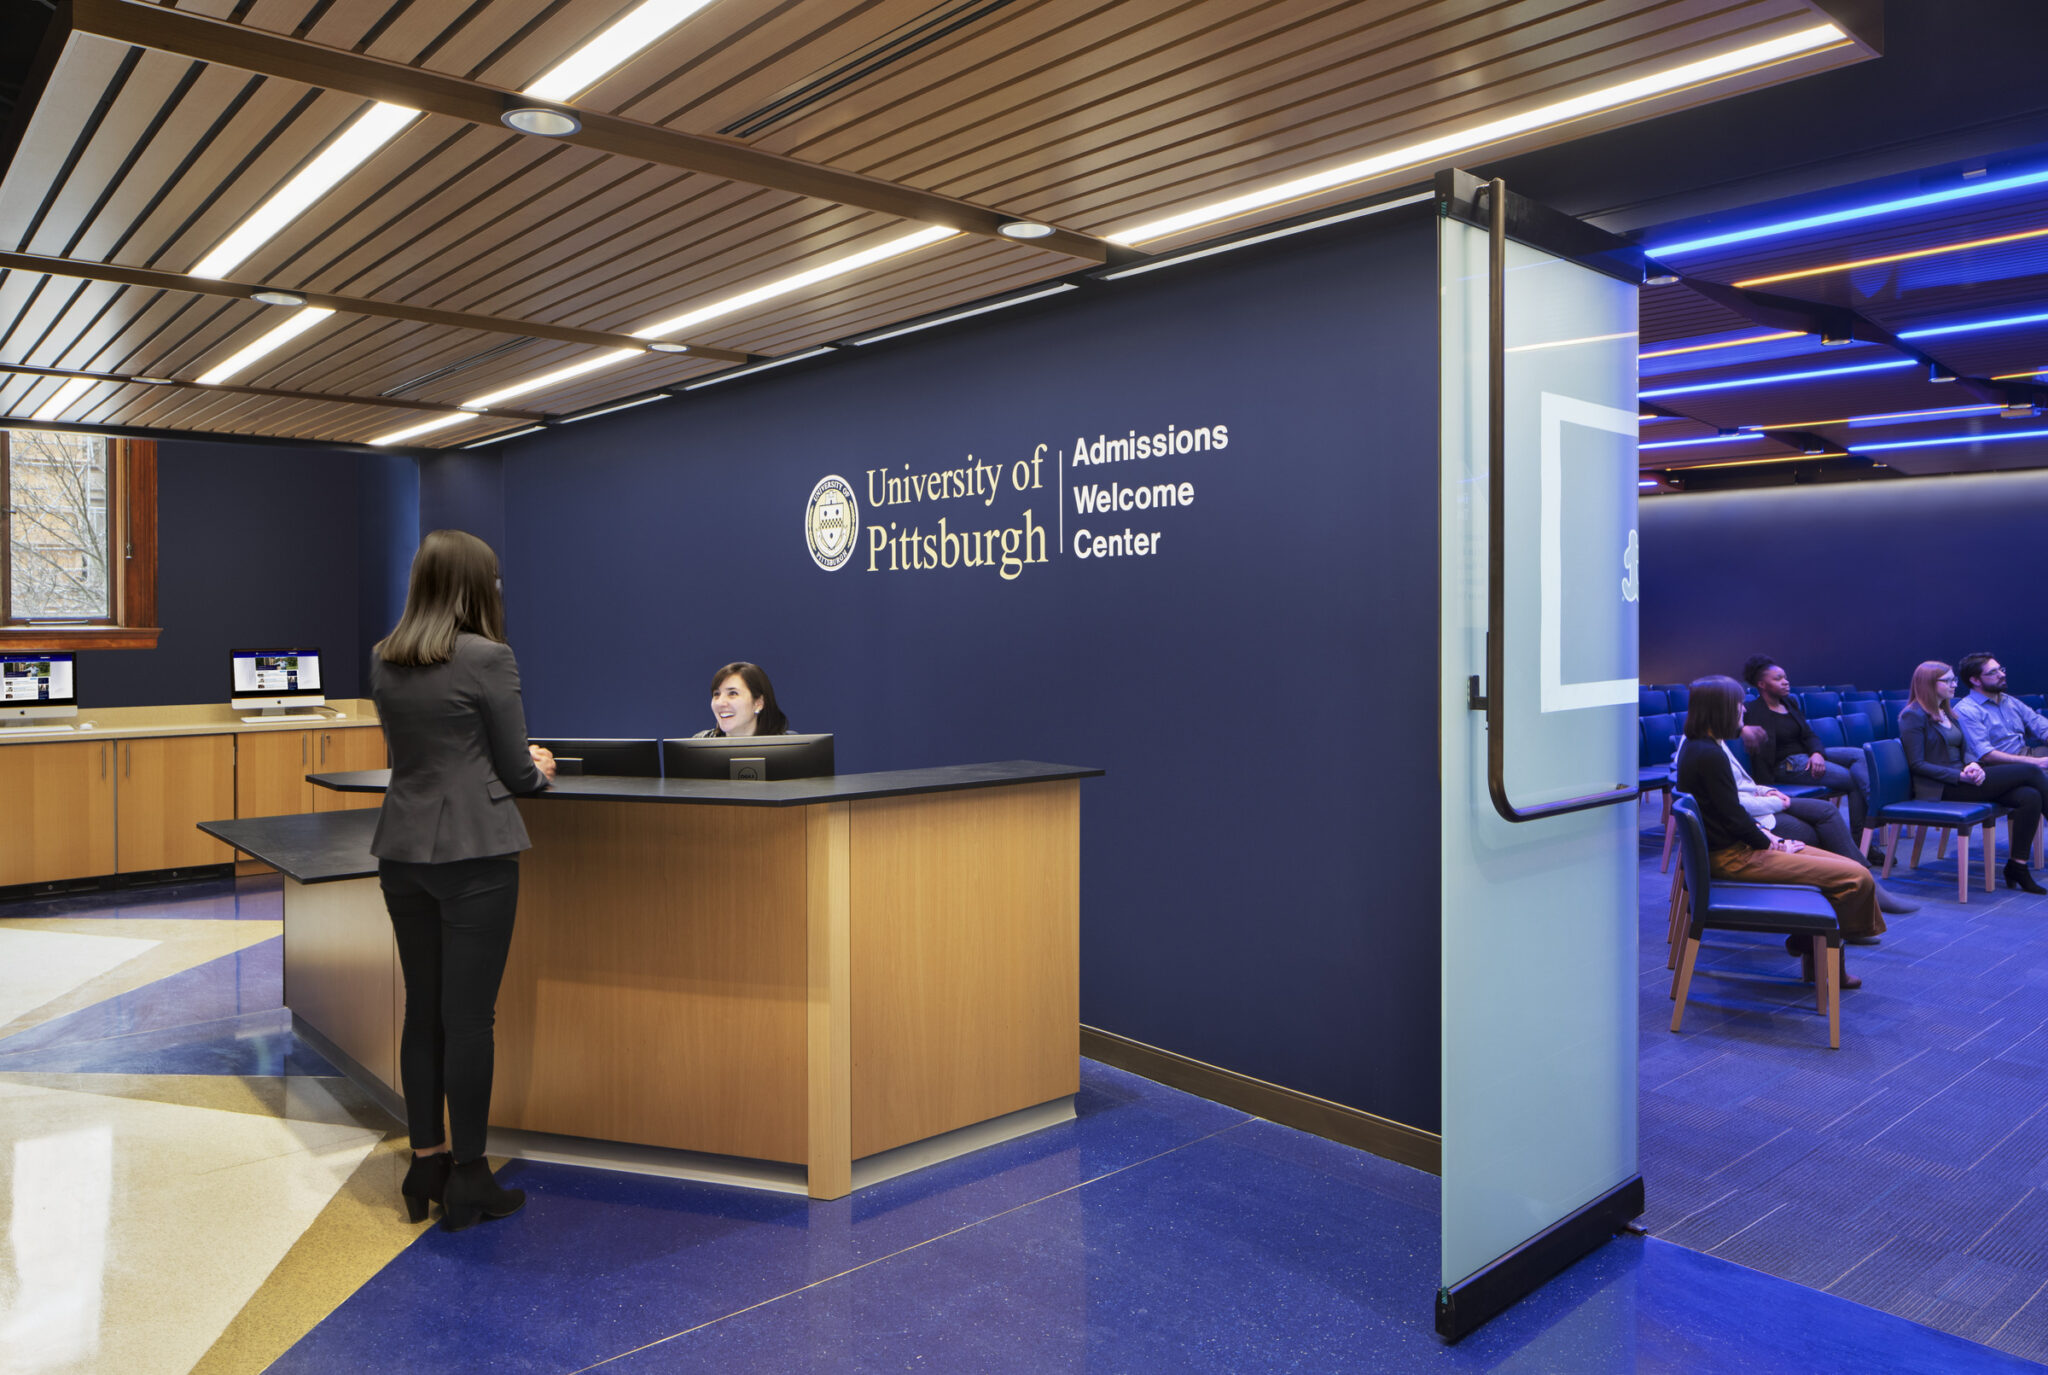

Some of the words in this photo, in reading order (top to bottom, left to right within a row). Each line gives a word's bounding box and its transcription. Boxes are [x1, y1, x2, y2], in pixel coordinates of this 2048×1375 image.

[1072, 424, 1229, 467] Admissions
[866, 454, 1004, 507] University
[1011, 443, 1048, 491] of
[1072, 482, 1195, 515] Welcome
[866, 509, 1049, 581] Pittsburgh
[1073, 528, 1162, 559] Center
